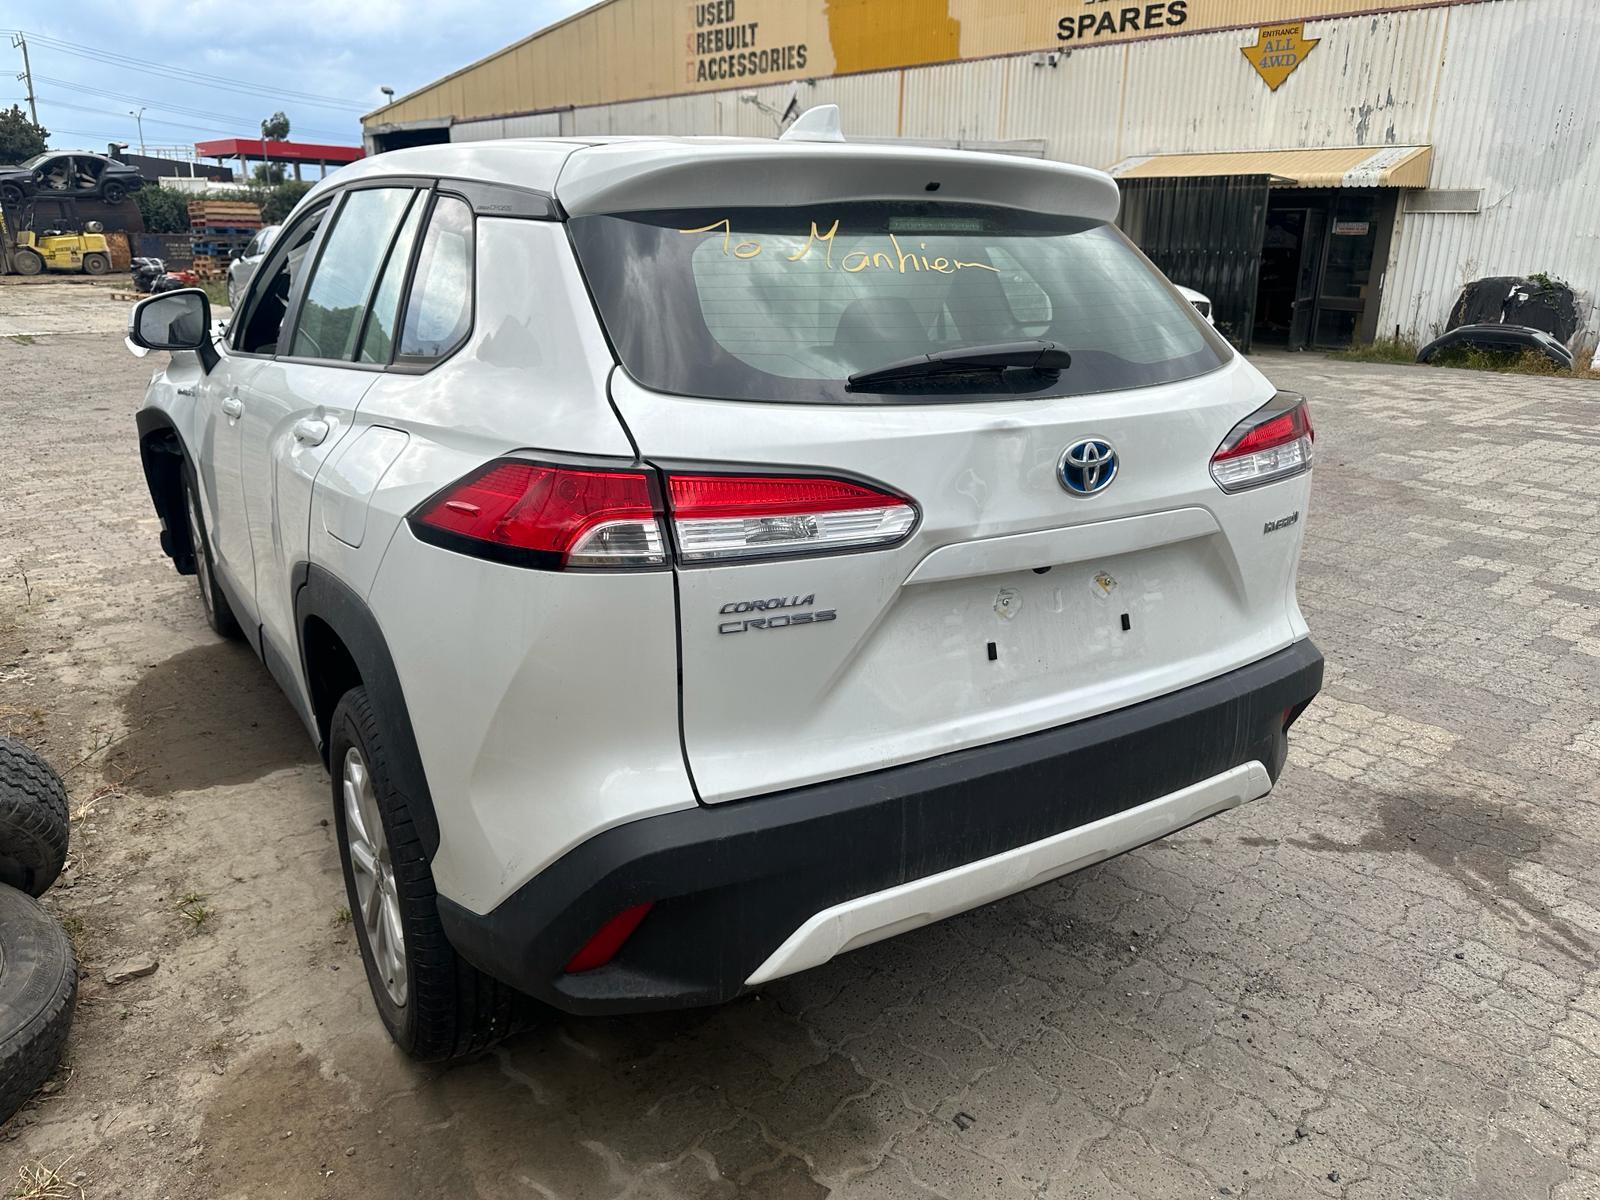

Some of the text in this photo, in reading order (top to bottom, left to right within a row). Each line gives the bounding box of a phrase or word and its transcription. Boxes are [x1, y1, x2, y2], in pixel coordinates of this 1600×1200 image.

[696, 0, 735, 27] USED
[1057, 0, 1188, 41] SPARES
[696, 22, 758, 55] REBUILT
[1262, 26, 1300, 38] ENTRANCE
[1263, 38, 1296, 53] ALL
[697, 44, 808, 82] ACCESSORIES
[719, 593, 815, 614] COROLLA
[718, 608, 837, 634] CROSS
